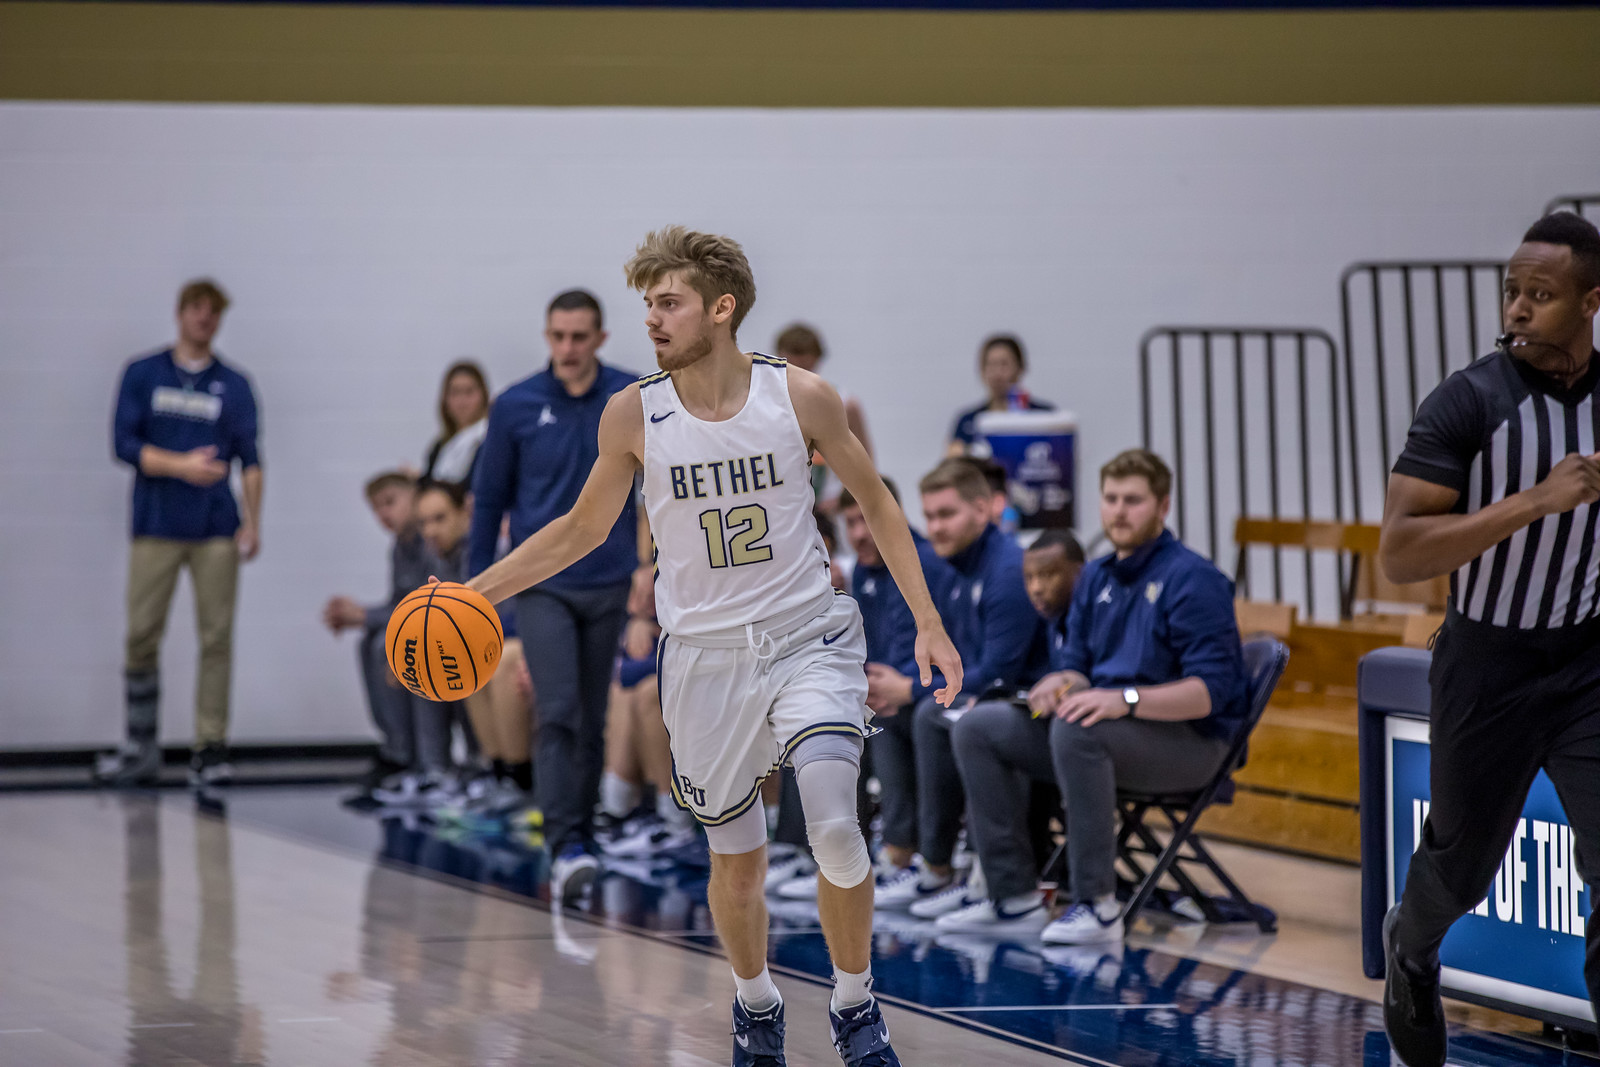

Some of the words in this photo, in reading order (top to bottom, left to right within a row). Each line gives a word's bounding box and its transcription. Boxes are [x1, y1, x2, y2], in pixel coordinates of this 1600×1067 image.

[669, 453, 784, 500] BETHEL
[699, 503, 773, 569] 12
[680, 775, 706, 808] BU
[1495, 817, 1527, 924] OF
[1533, 819, 1585, 937] THE
